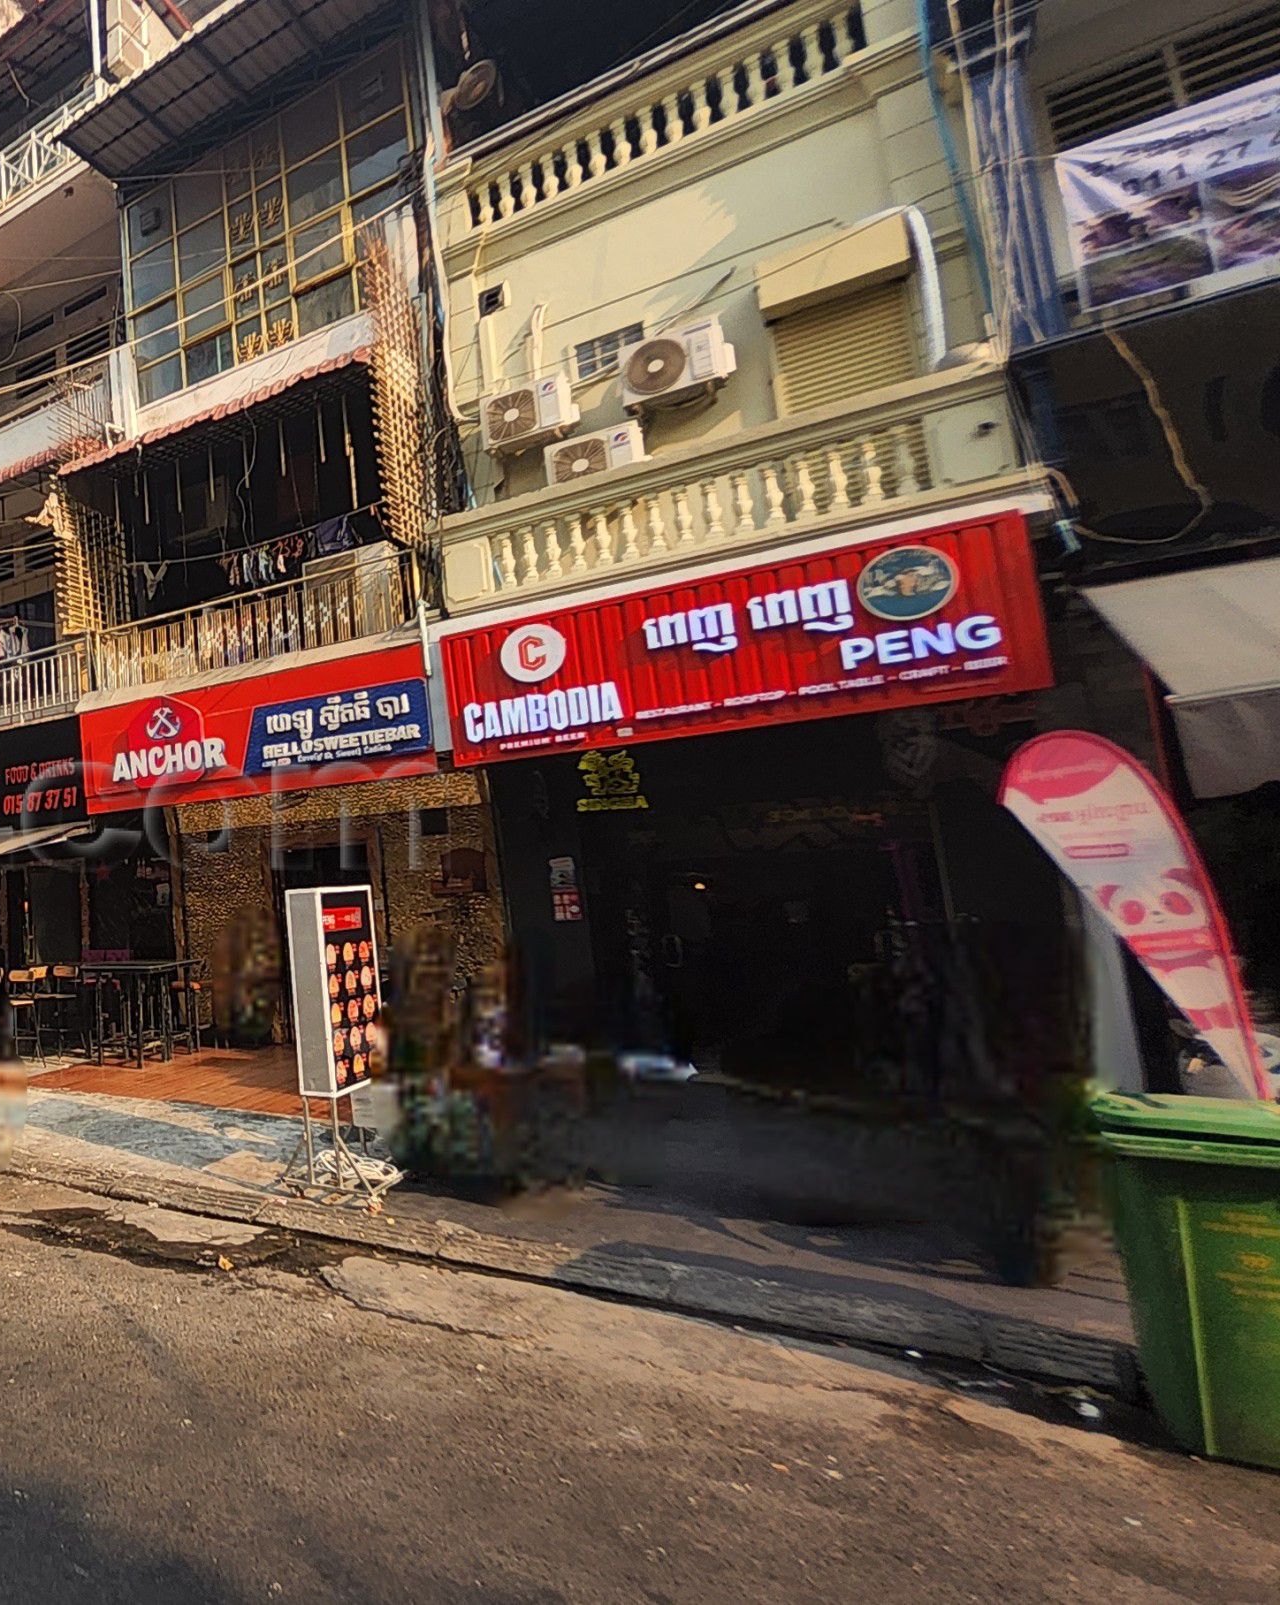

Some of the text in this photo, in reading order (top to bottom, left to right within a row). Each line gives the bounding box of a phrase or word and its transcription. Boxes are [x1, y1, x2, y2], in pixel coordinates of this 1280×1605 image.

[839, 615, 1002, 671] PENG
[463, 681, 624, 743] CAMBODIA
[5, 757, 75, 785] FOOD & DRINKS
[112, 737, 227, 782] ANCHOR
[3, 794, 23, 815] 015
[44, 789, 61, 810] 37
[63, 786, 77, 808] 51
